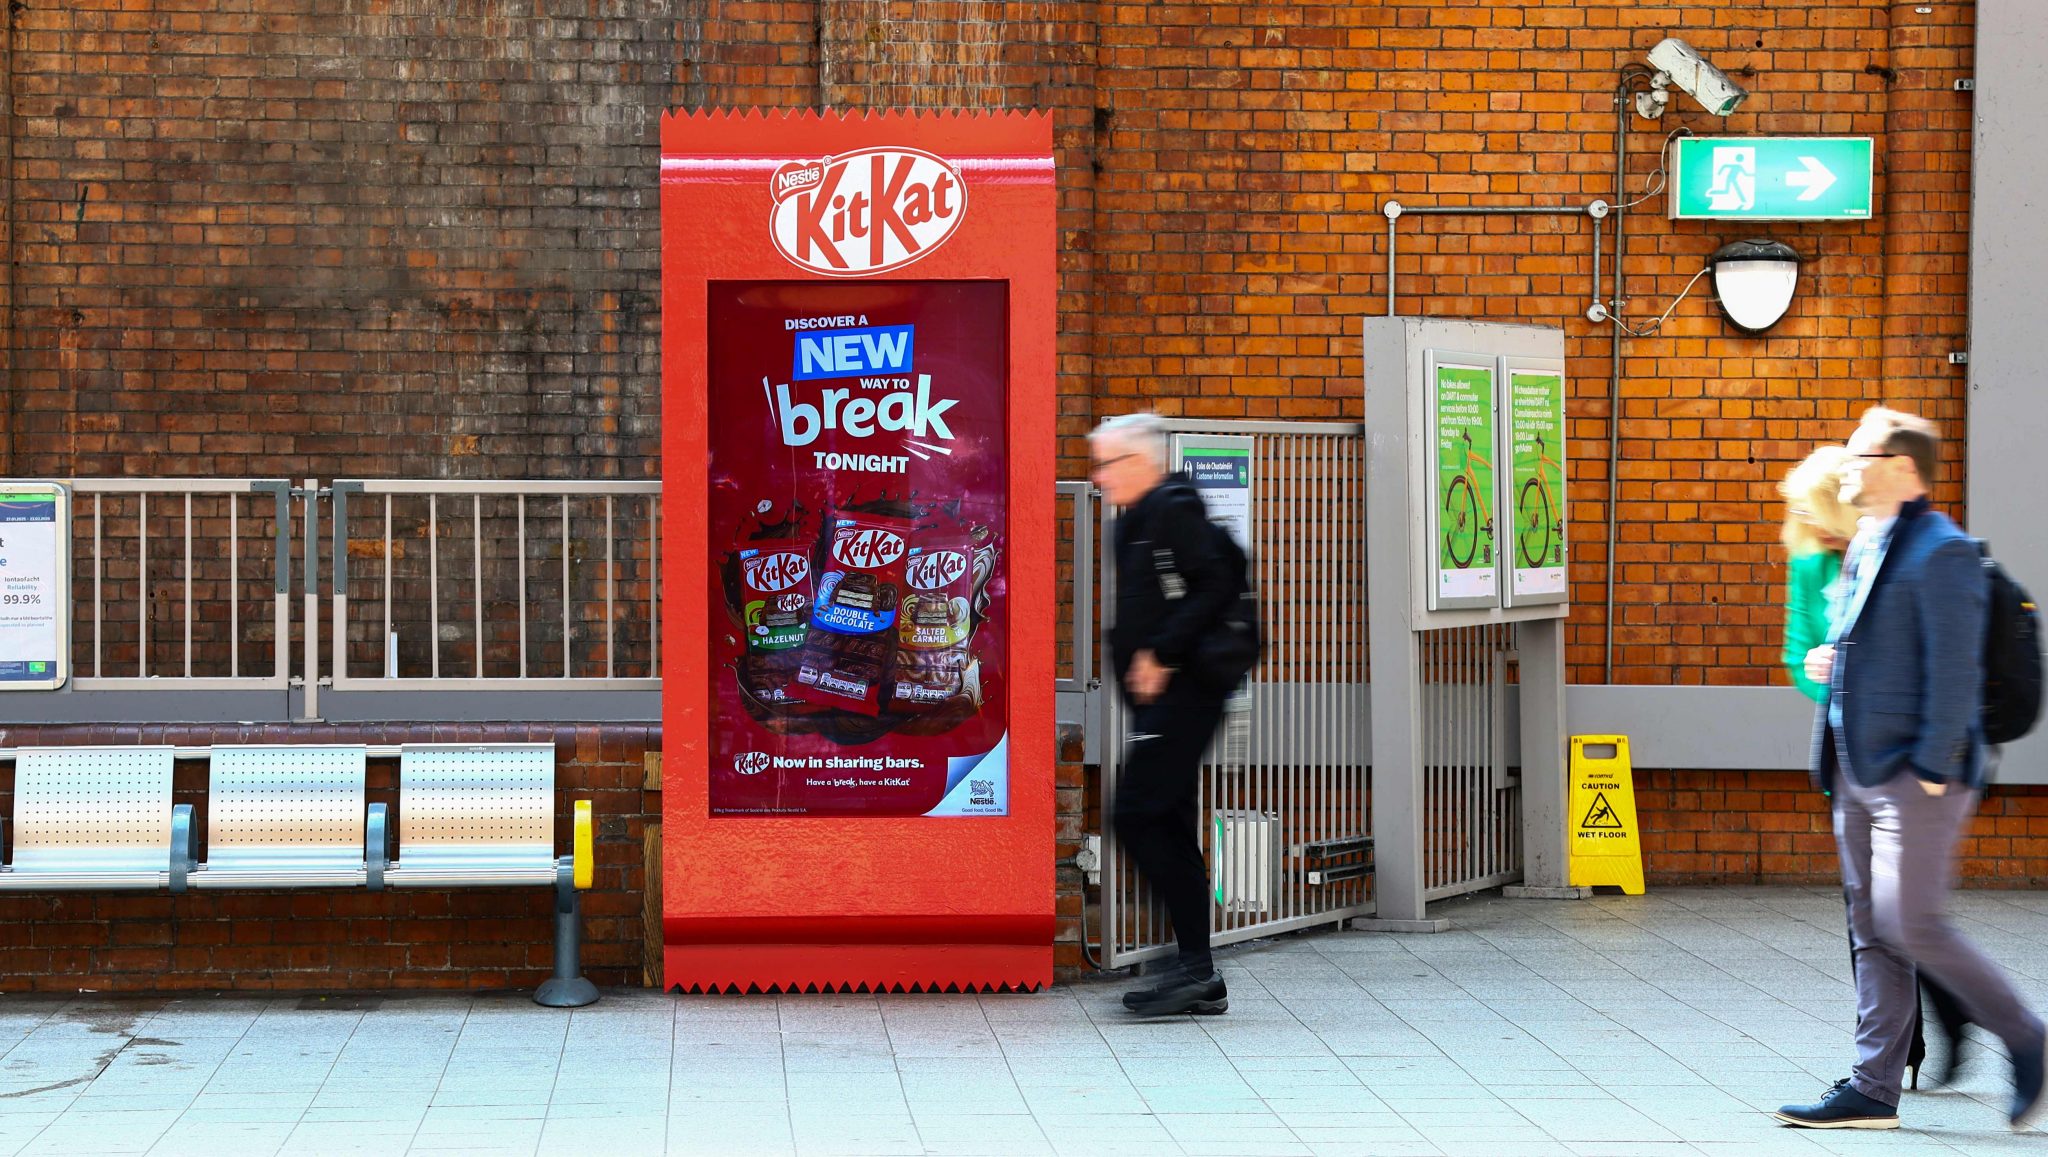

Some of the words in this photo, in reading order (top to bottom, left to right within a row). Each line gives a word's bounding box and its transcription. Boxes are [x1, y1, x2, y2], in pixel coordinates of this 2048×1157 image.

[778, 166, 820, 190] Nestlé
[796, 154, 954, 269] KitKat
[785, 315, 855, 331] DISCOVER
[858, 314, 868, 326] A
[800, 331, 908, 373] NEW
[860, 378, 889, 389] WAY
[892, 378, 910, 389] TO
[776, 374, 960, 446] break
[814, 452, 909, 473] TONIGHT
[1197, 472, 1213, 480] Customer
[1214, 472, 1234, 480] Information
[838, 530, 903, 567] KitKat
[753, 553, 806, 590] KitKat
[911, 552, 964, 589] KitKat
[7, 584, 38, 592] Reliability
[4, 594, 41, 605] 99.9%
[780, 593, 804, 611] KitKat
[824, 614, 875, 631] CHOCOLATE
[833, 607, 869, 621] DOUBLE
[762, 634, 804, 645] HAZELNUT
[912, 635, 949, 643] CARAMEL
[916, 628, 946, 636] SALTED
[738, 752, 768, 774] KitKat
[773, 756, 806, 769] Now
[809, 756, 823, 769] in
[825, 756, 884, 771] sharing
[885, 756, 924, 769] bars.
[806, 778, 826, 786] Have
[834, 778, 858, 787] break,
[859, 778, 876, 786] have
